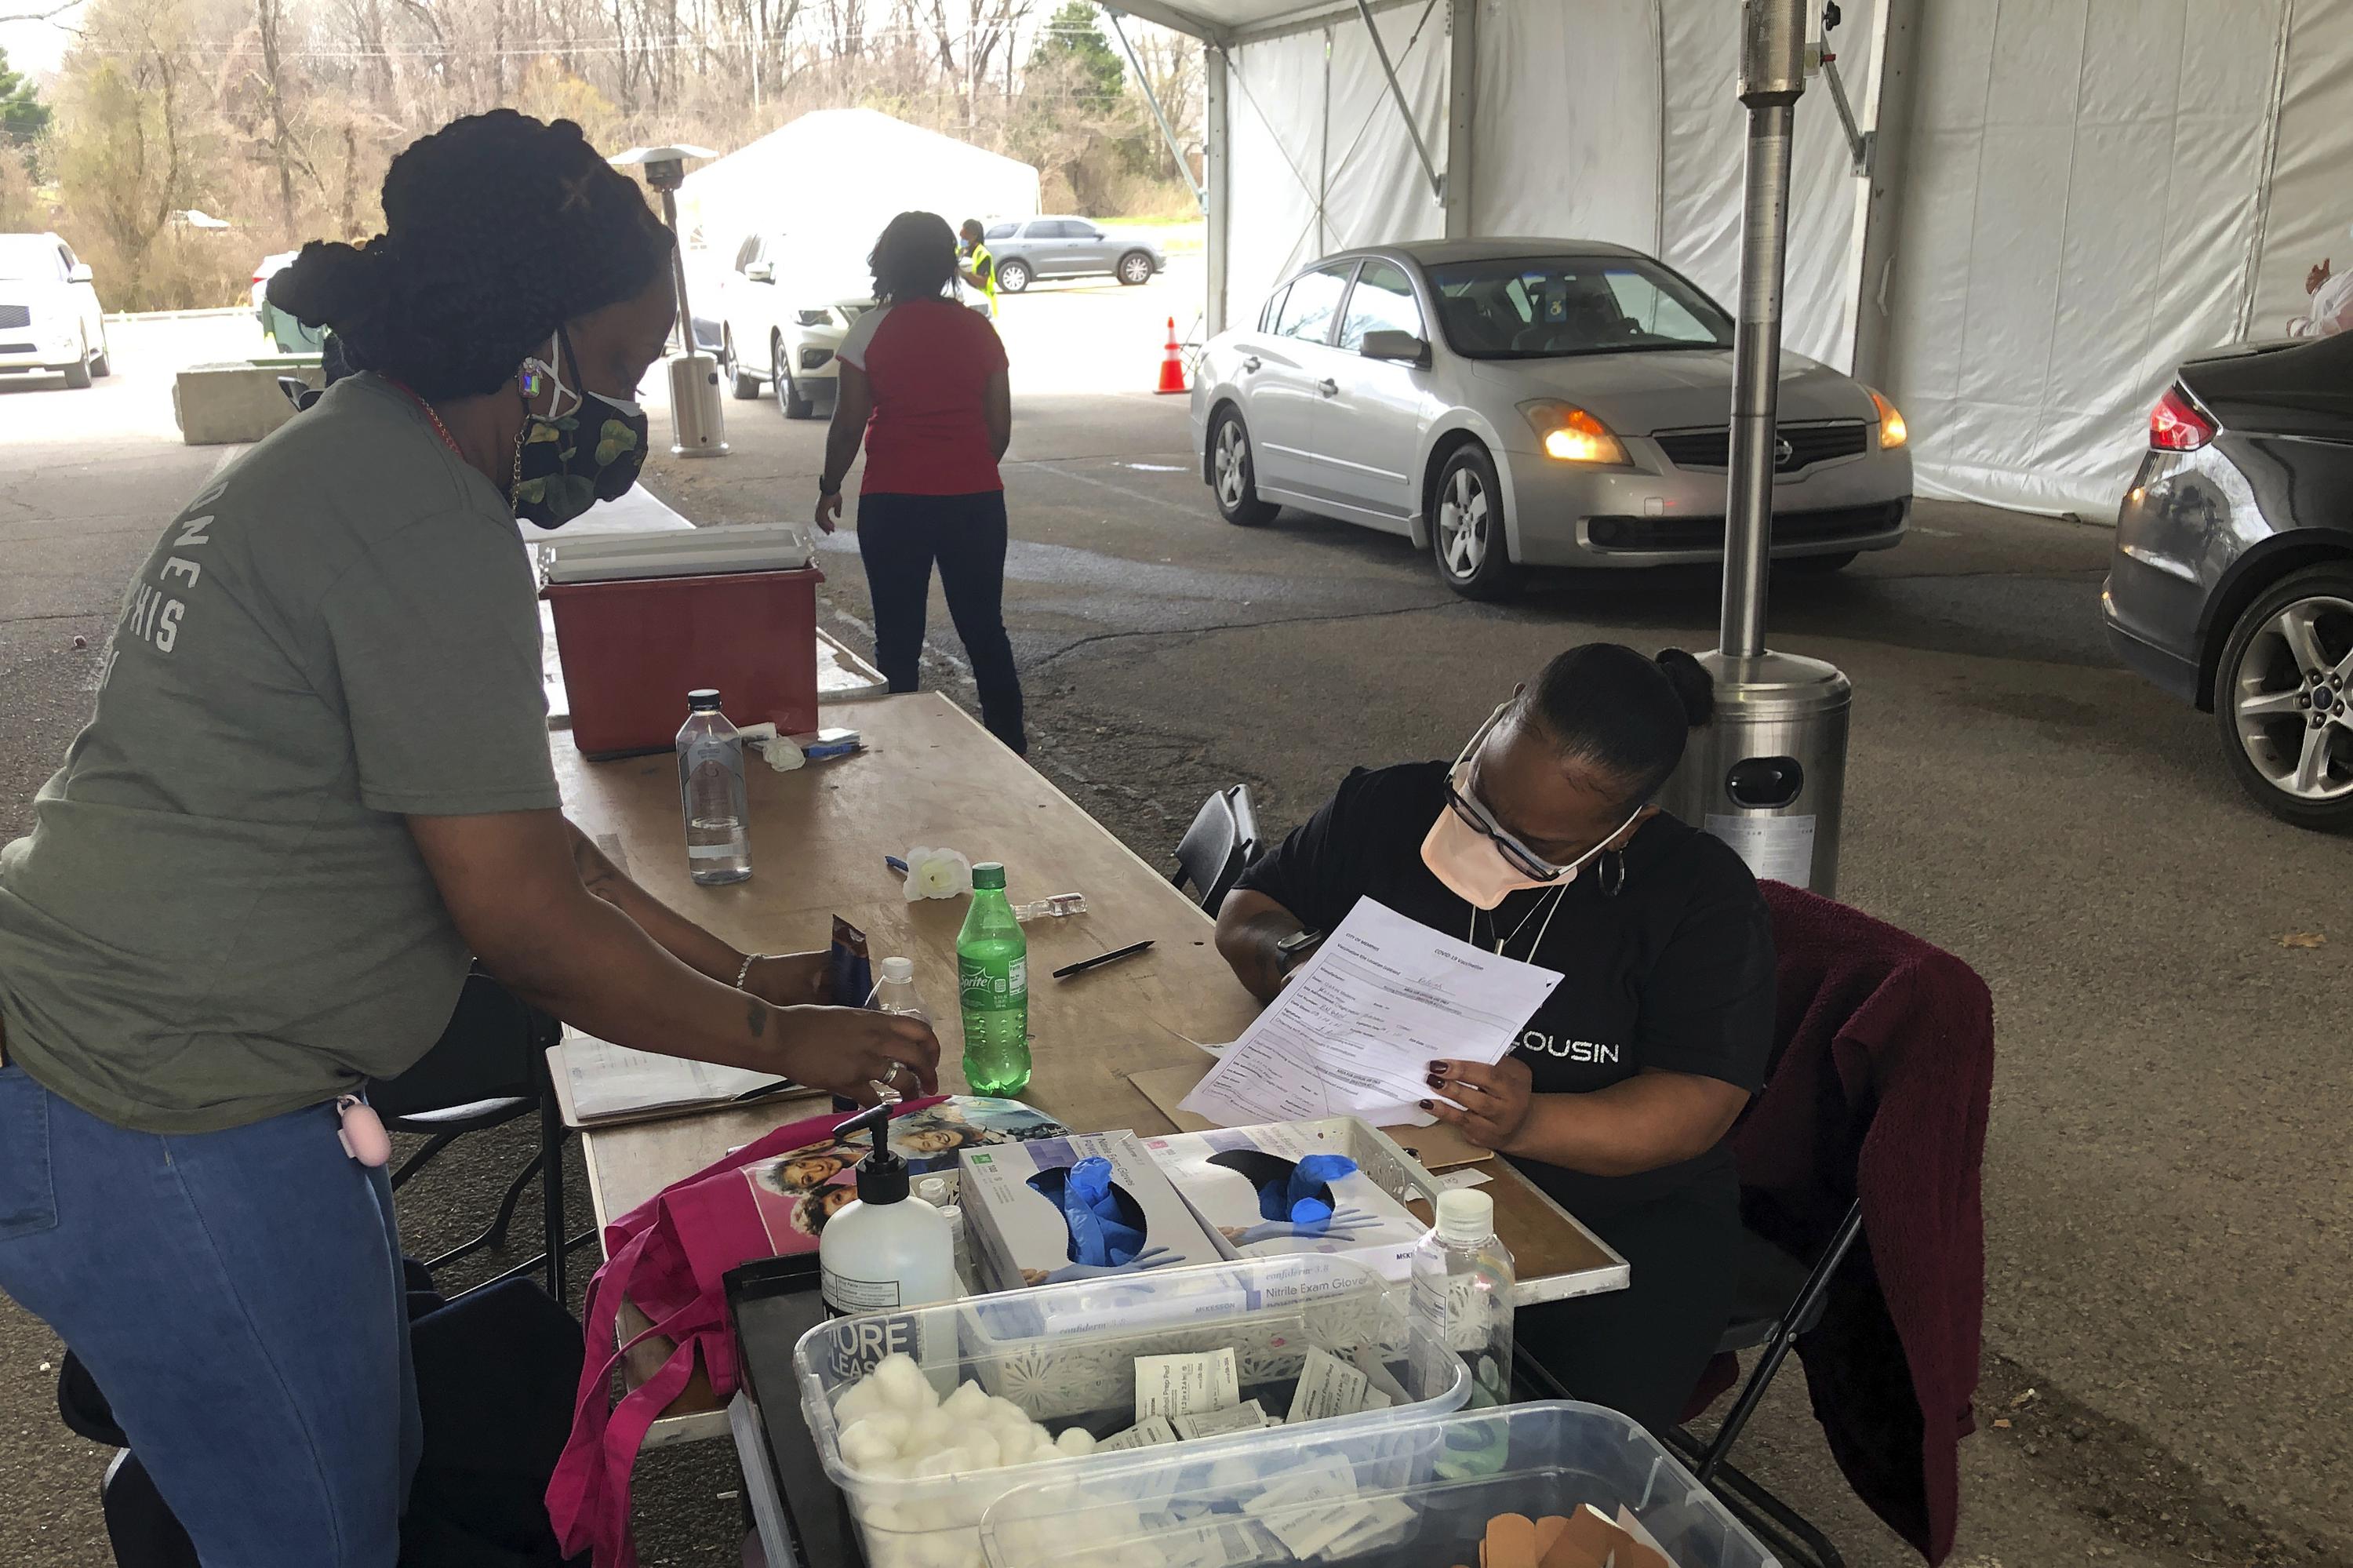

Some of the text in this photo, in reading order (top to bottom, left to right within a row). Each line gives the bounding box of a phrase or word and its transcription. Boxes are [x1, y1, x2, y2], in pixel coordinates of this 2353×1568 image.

[120, 583, 186, 653] HIS
[961, 974, 987, 988] Sprite
[1117, 1167, 1135, 1186] Gloves
[1266, 1285, 1297, 1299] Nitrile
[1300, 1280, 1329, 1294] Exam
[829, 1347, 877, 1378] LEAS
